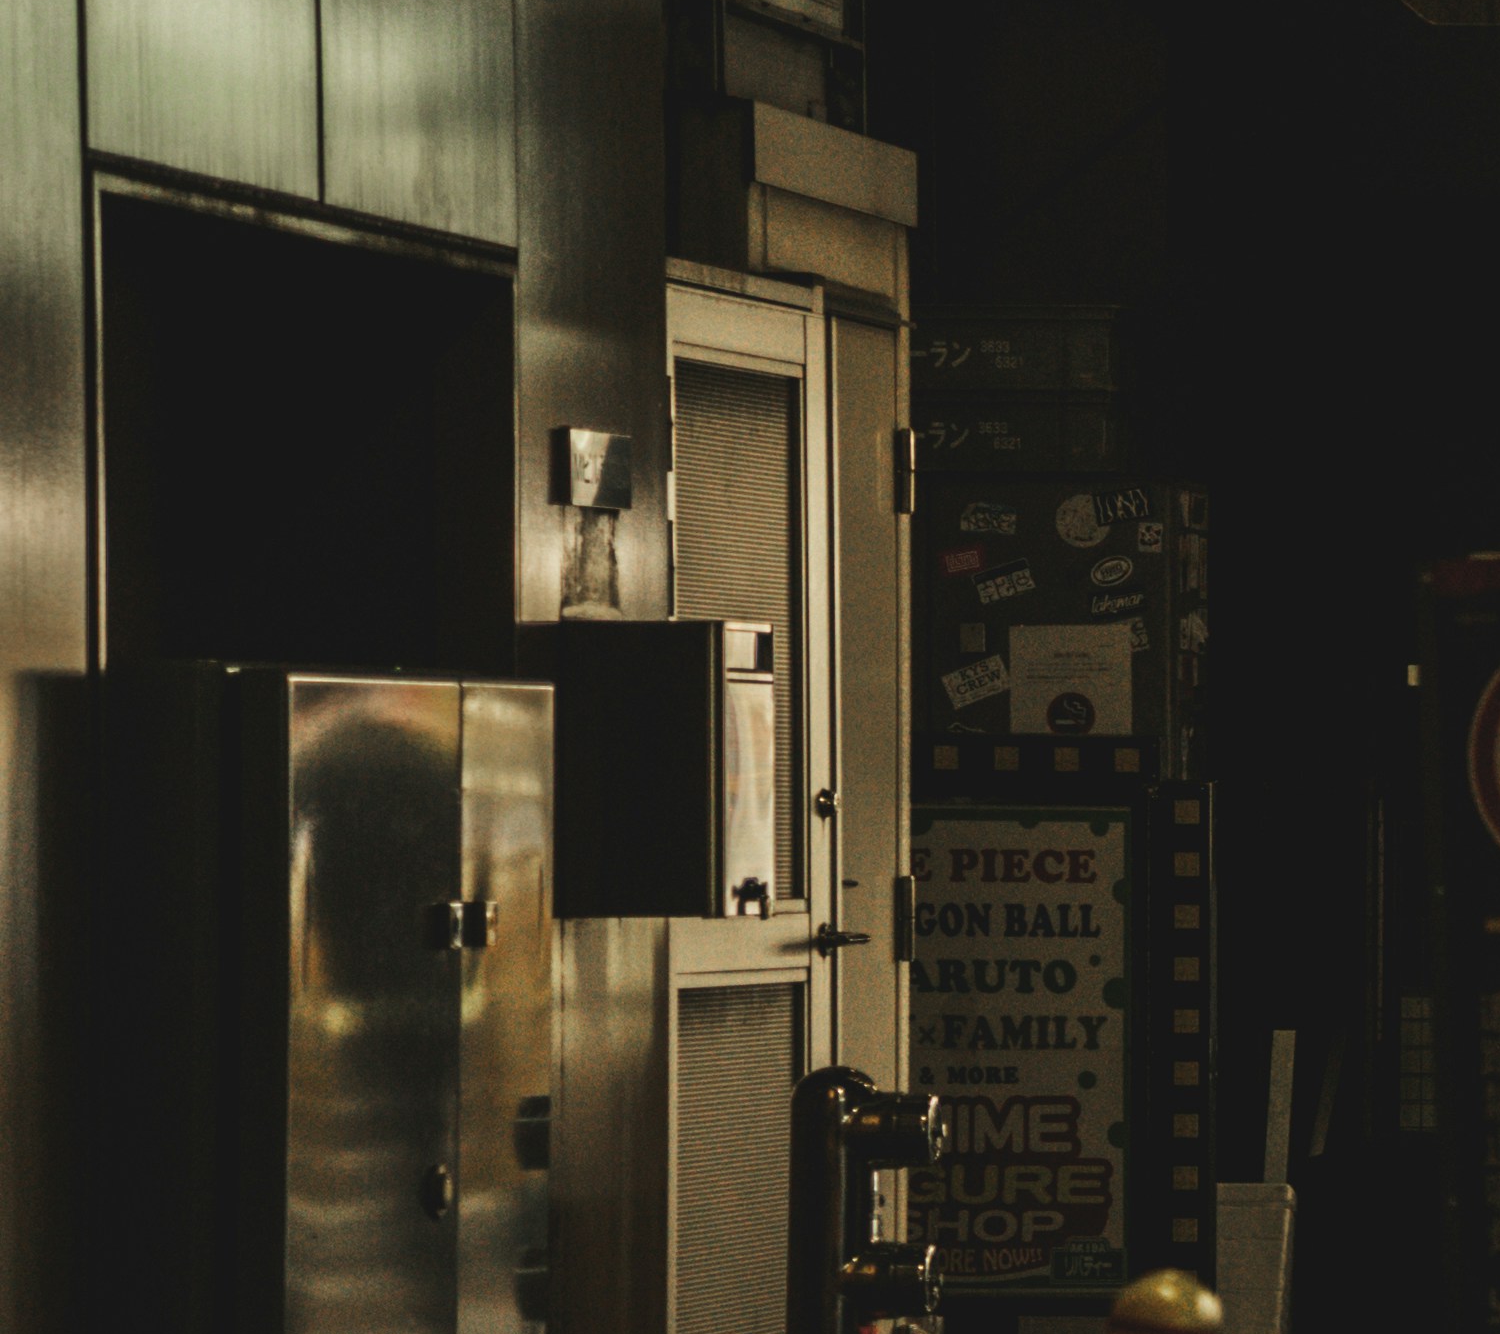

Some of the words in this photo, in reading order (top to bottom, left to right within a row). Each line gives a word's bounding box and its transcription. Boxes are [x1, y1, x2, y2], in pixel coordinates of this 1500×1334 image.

[956, 670, 1002, 697] CREW
[949, 848, 1098, 884] PIECE
[915, 902, 992, 937] GON
[1003, 903, 1101, 938] BALL
[910, 959, 1078, 994] ARUTO
[910, 1015, 1107, 1050] ×FAMILY
[947, 1066, 1019, 1085] MORE
